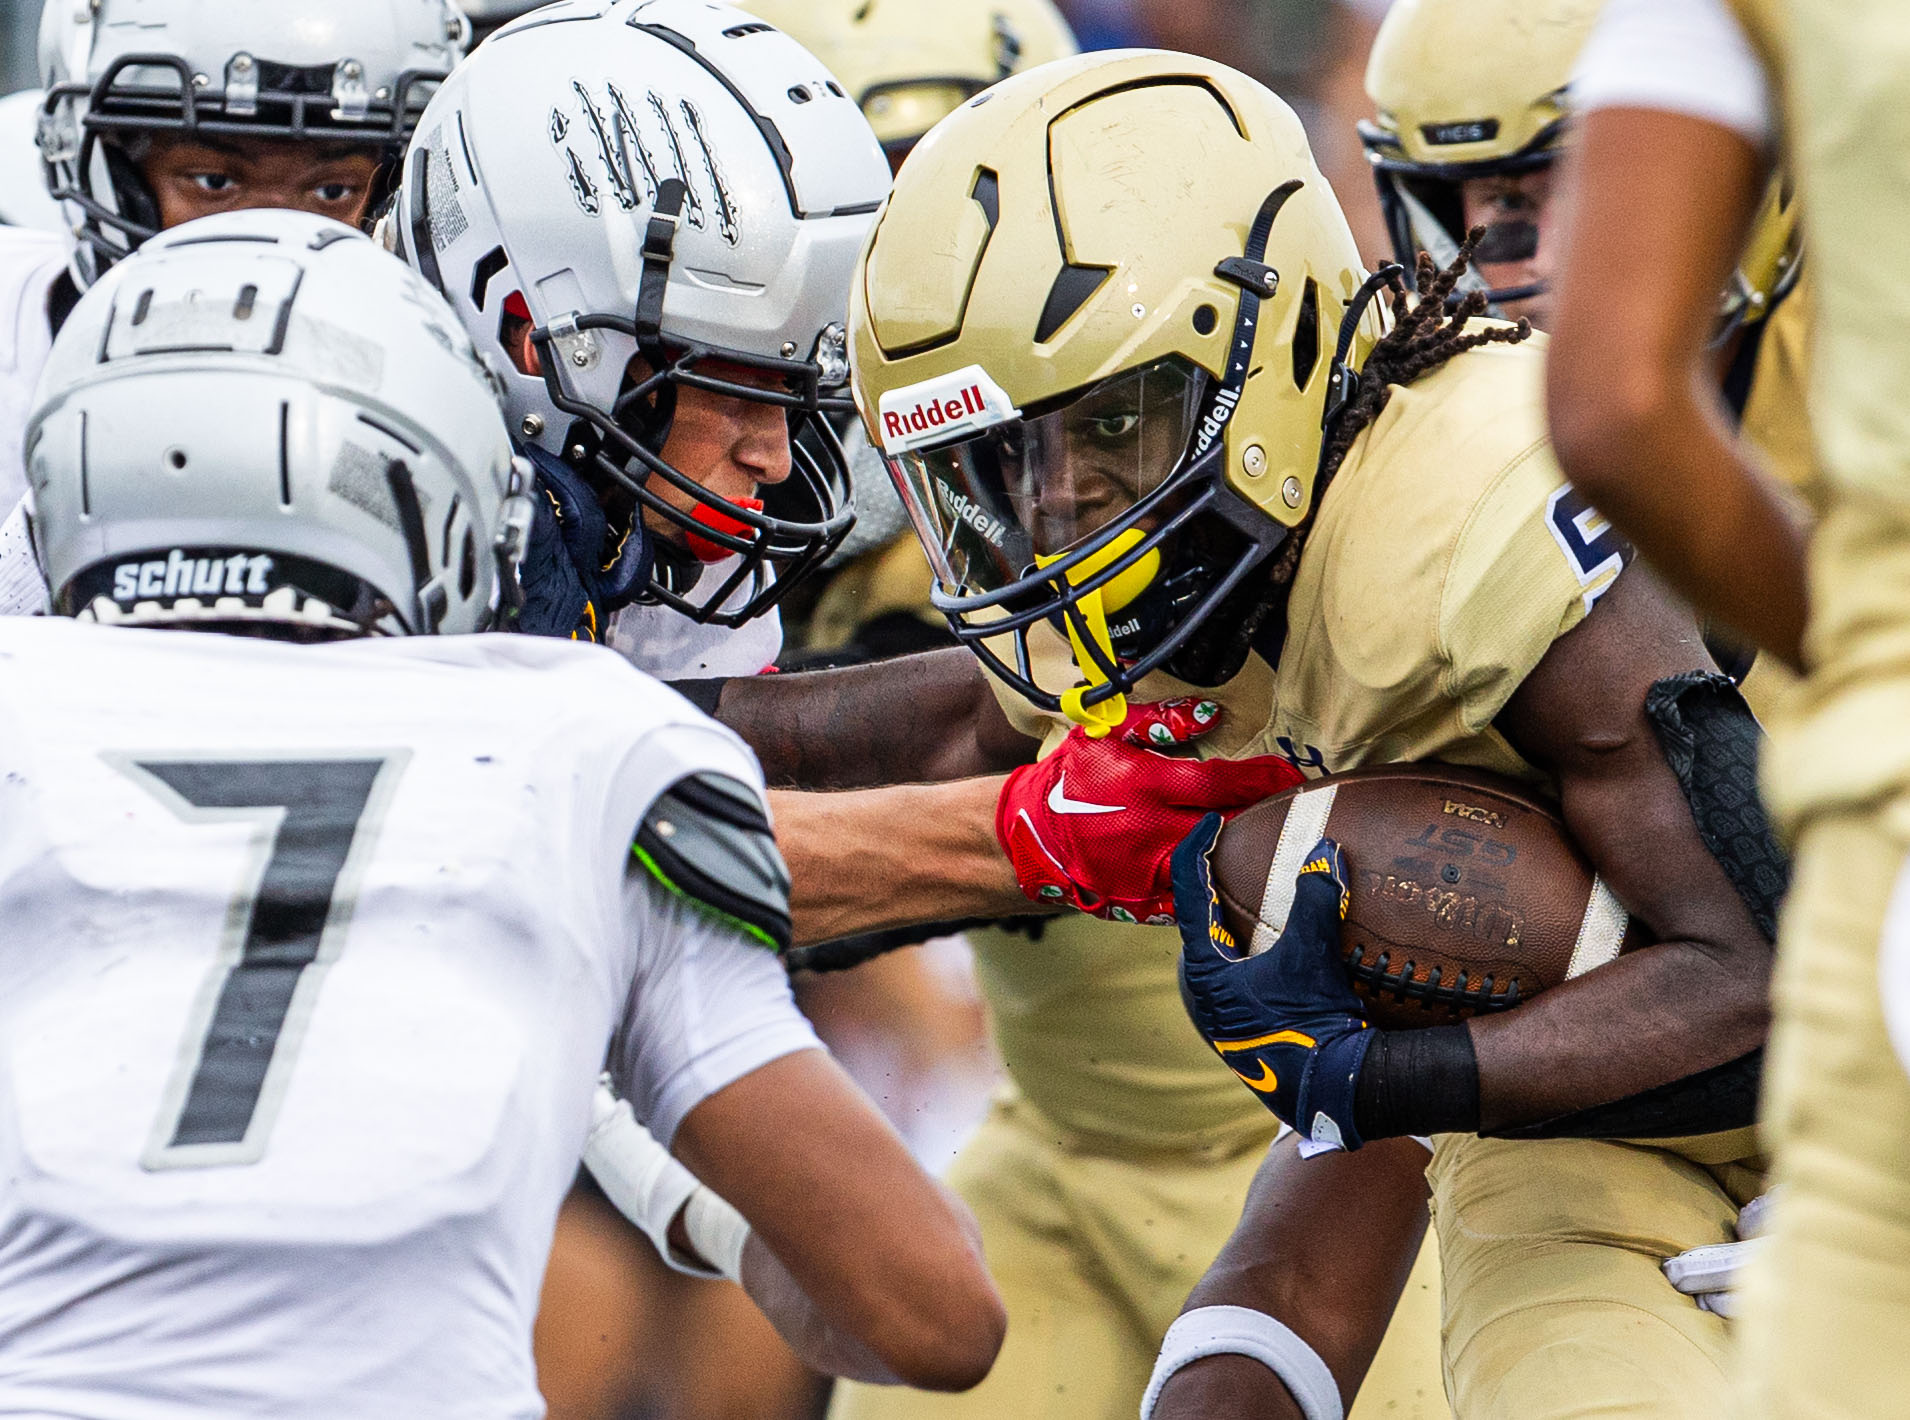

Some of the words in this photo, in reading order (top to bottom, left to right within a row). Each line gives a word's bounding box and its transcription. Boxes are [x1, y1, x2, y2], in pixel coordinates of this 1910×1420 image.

[883, 384, 986, 439] Riddell
[1191, 388, 1240, 461] iddell
[935, 476, 1006, 545] Riddell
[113, 549, 273, 600] schutt
[1405, 823, 1518, 867] GST
[98, 747, 414, 1172] 7
